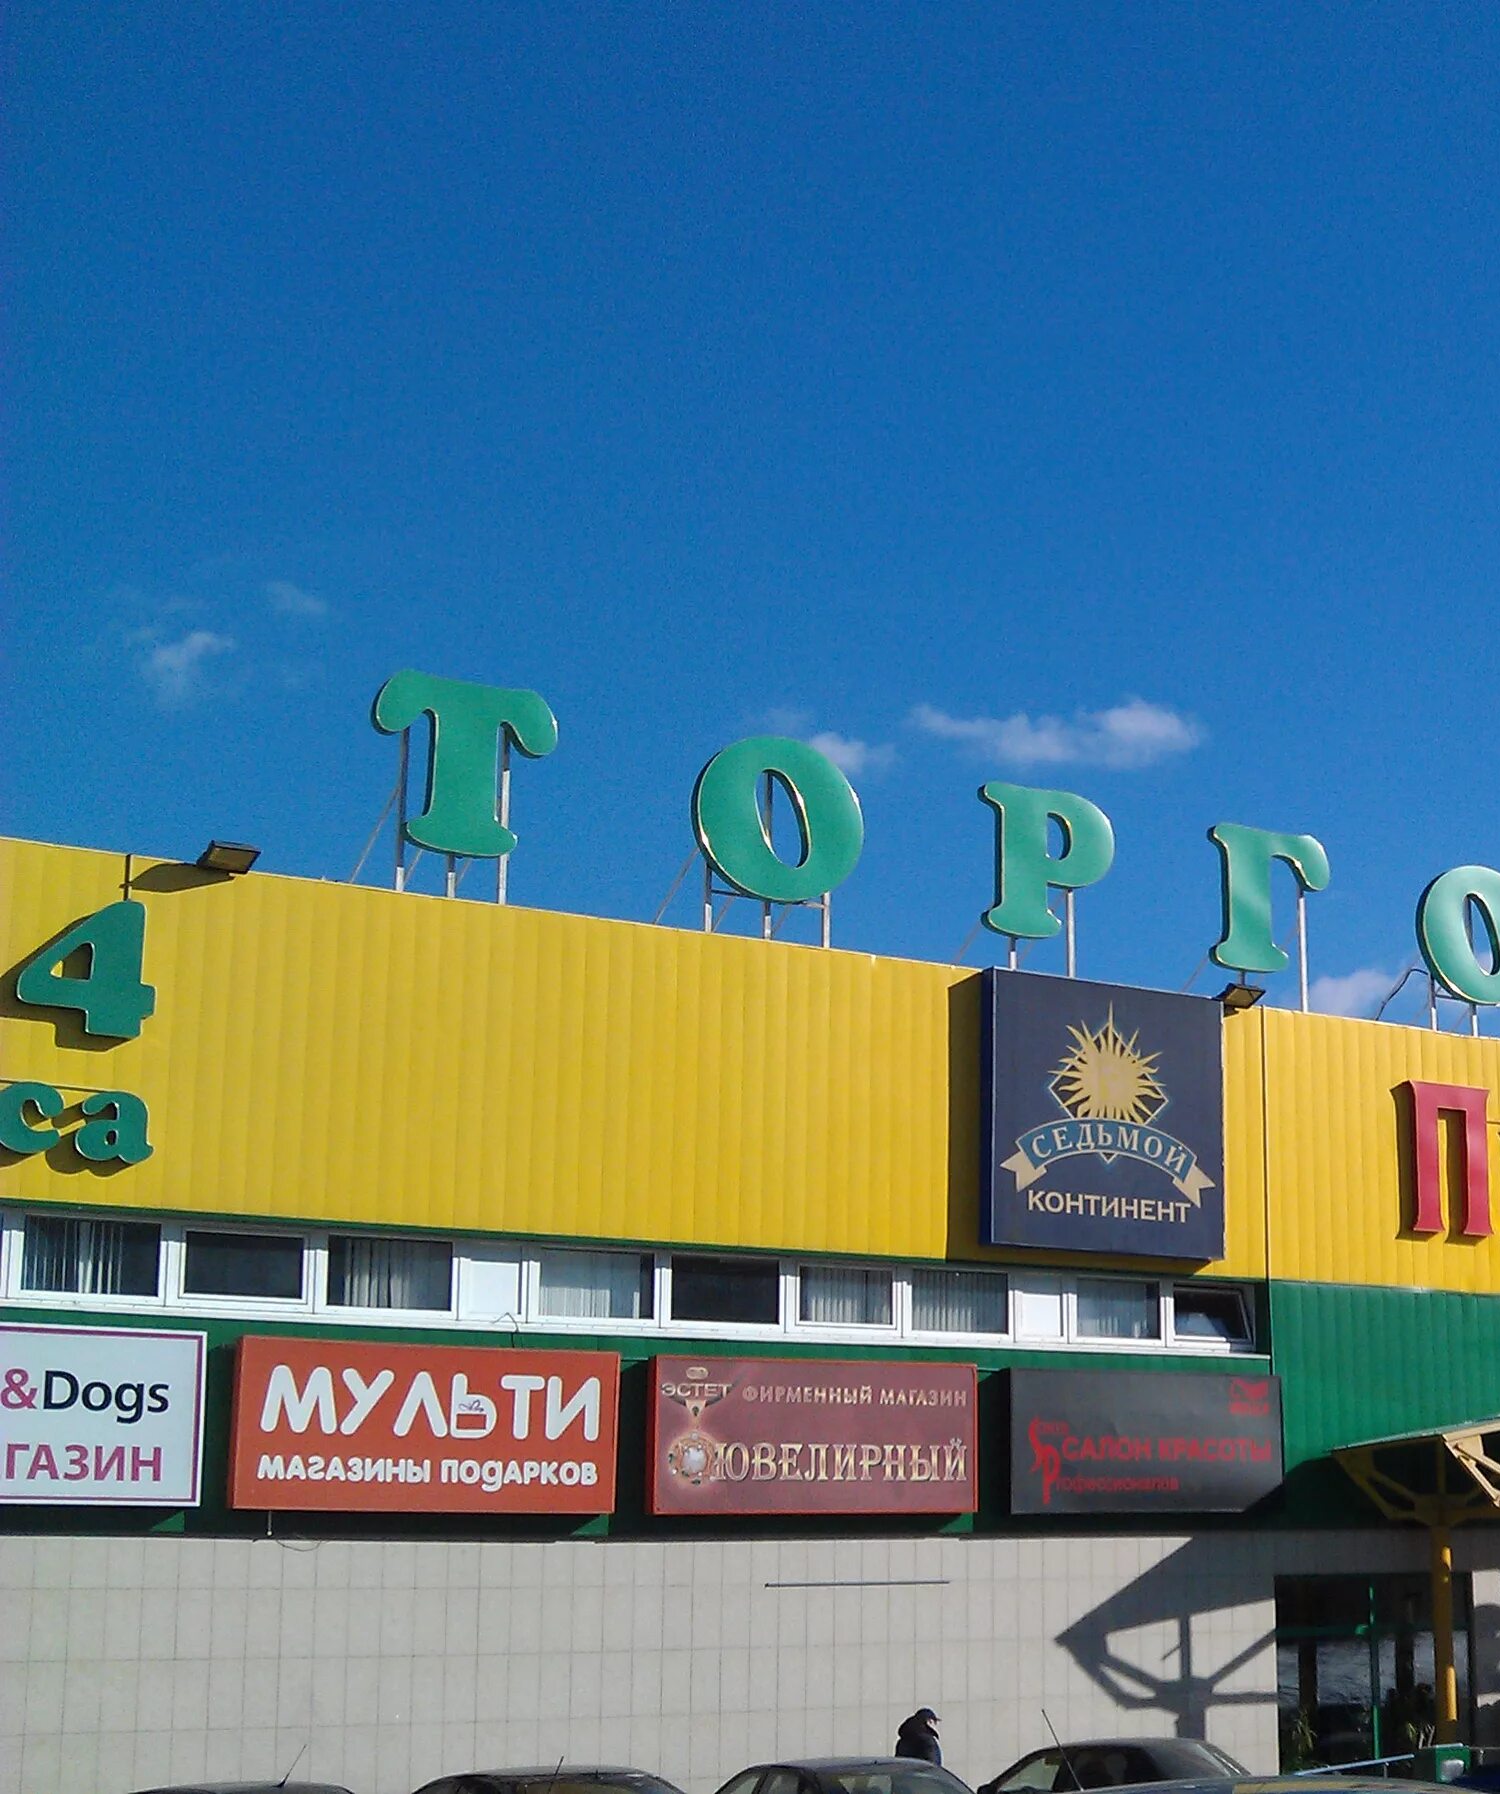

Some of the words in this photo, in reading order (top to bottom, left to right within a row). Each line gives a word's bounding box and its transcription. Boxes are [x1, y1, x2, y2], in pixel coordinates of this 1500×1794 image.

[16, 899, 156, 1038] 4
[1030, 1123, 1187, 1179] СЕДЬМОЙ
[1028, 1189, 1192, 1224] КОНТИНЕНТ
[0, 1368, 170, 1424] &Dogs
[260, 1364, 601, 1441] МУЛЬТИ
[661, 1383, 732, 1398] ЭСТЕТ
[742, 1384, 873, 1405] ФИРМЕННЫЙ
[879, 1388, 968, 1407] МАГАЗИН
[5, 1443, 162, 1481] ГАЗИН
[709, 1437, 968, 1483] ЮВЕЛИРНЫЙ
[1061, 1436, 1152, 1462] САЛОН
[1157, 1437, 1273, 1463] КРАСОТЫ
